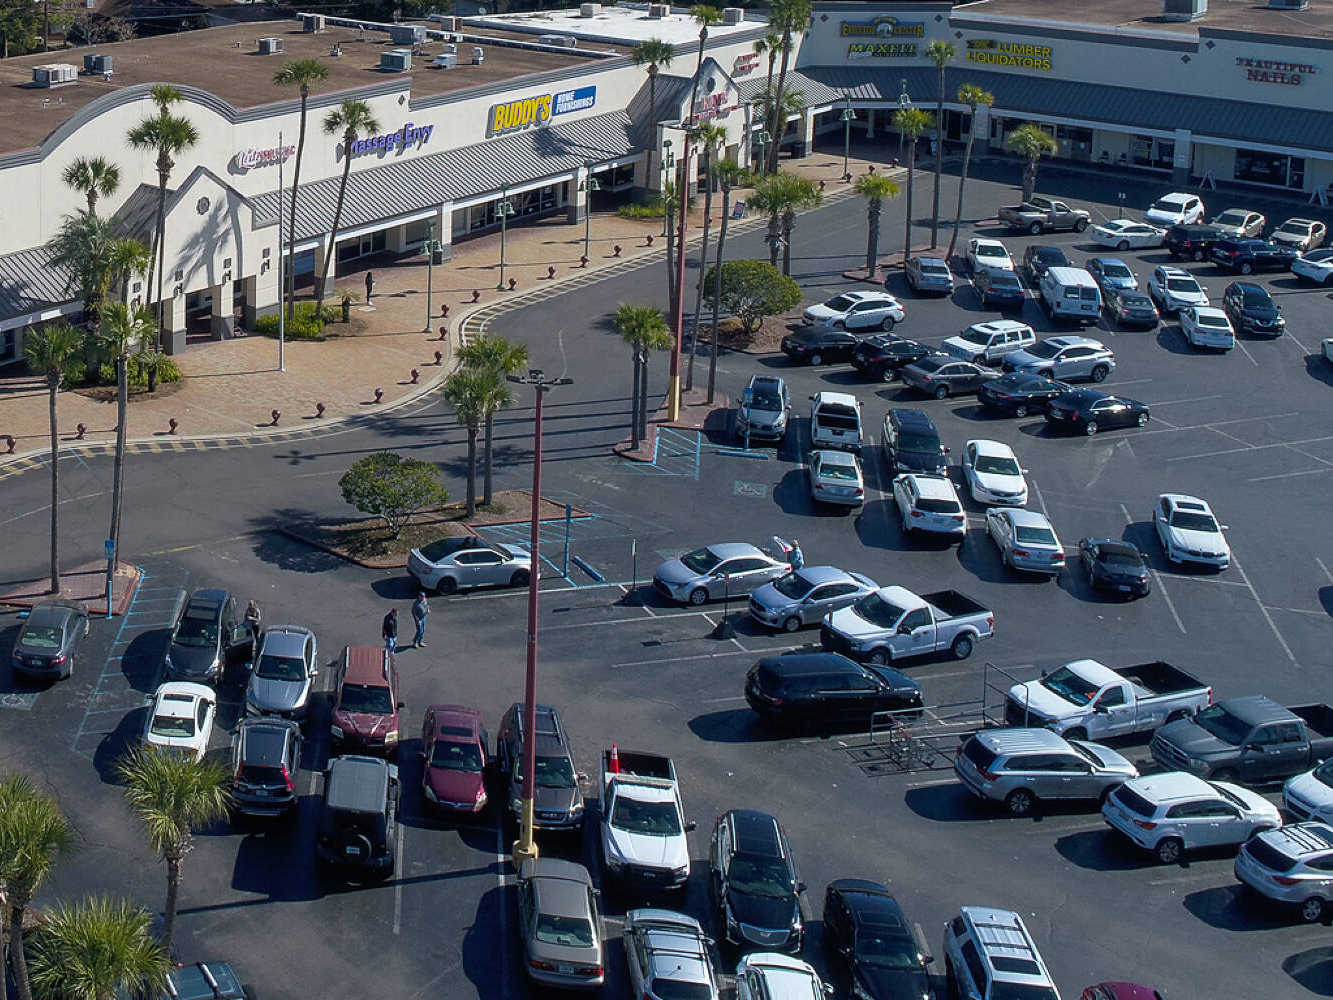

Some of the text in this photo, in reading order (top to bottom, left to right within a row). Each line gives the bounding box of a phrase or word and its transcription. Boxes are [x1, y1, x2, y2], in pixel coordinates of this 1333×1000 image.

[967, 50, 1051, 71] LIQUIDATORS
[997, 42, 1051, 58] LUMBER
[1247, 69, 1301, 85] NAILS
[493, 94, 551, 131] BUDDY'S
[404, 123, 435, 149] Envy
